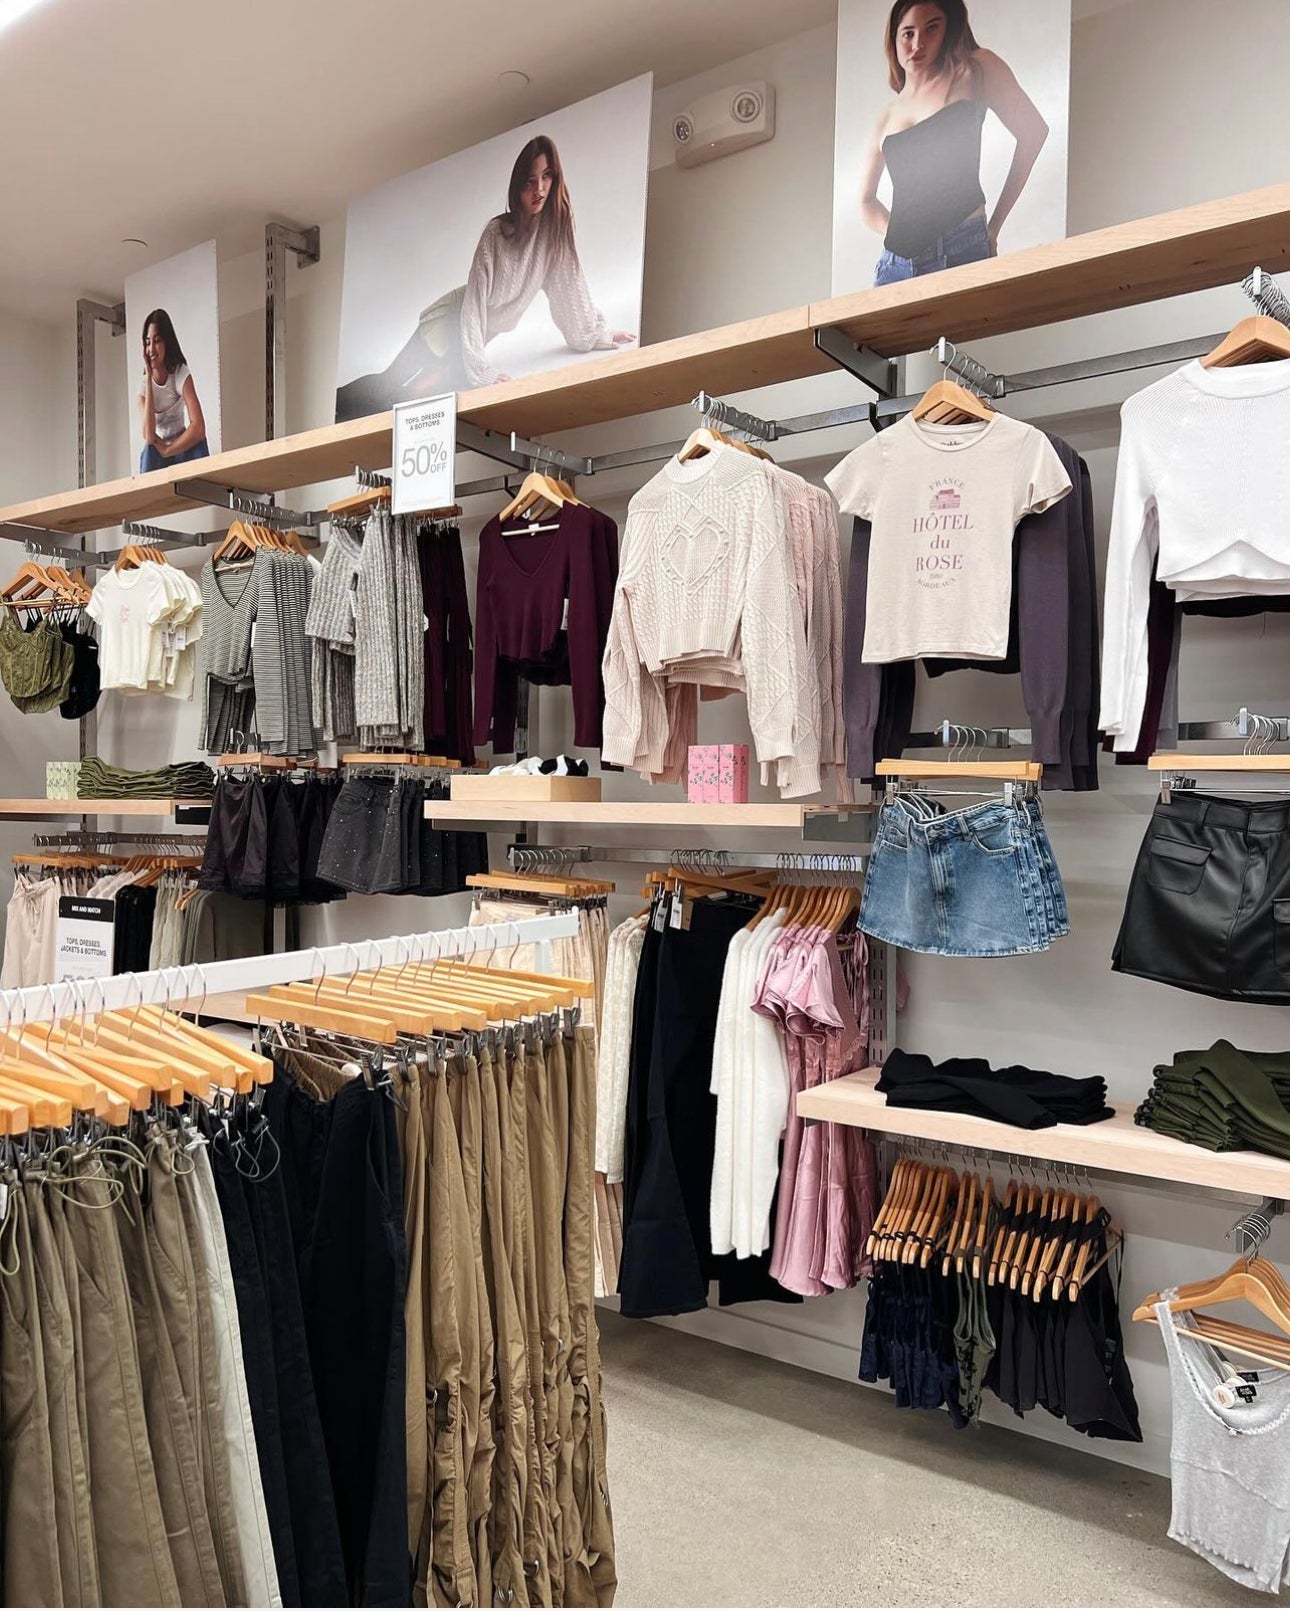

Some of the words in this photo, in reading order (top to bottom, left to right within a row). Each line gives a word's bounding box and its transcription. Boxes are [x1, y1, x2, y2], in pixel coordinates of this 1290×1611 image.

[421, 411, 445, 421] DRESSES
[414, 420, 440, 430] BOTTOMS
[402, 441, 447, 477] 50%
[430, 463, 447, 473] OFF
[929, 477, 967, 491] FRANCE
[912, 512, 975, 534] HÔTEL
[930, 534, 951, 549] du
[915, 554, 964, 572] ROSE
[917, 577, 957, 589] BORDEAUX
[79, 905, 87, 913] AND
[60, 946, 80, 954] JACKETS
[84, 948, 107, 956] BOTTOMS
